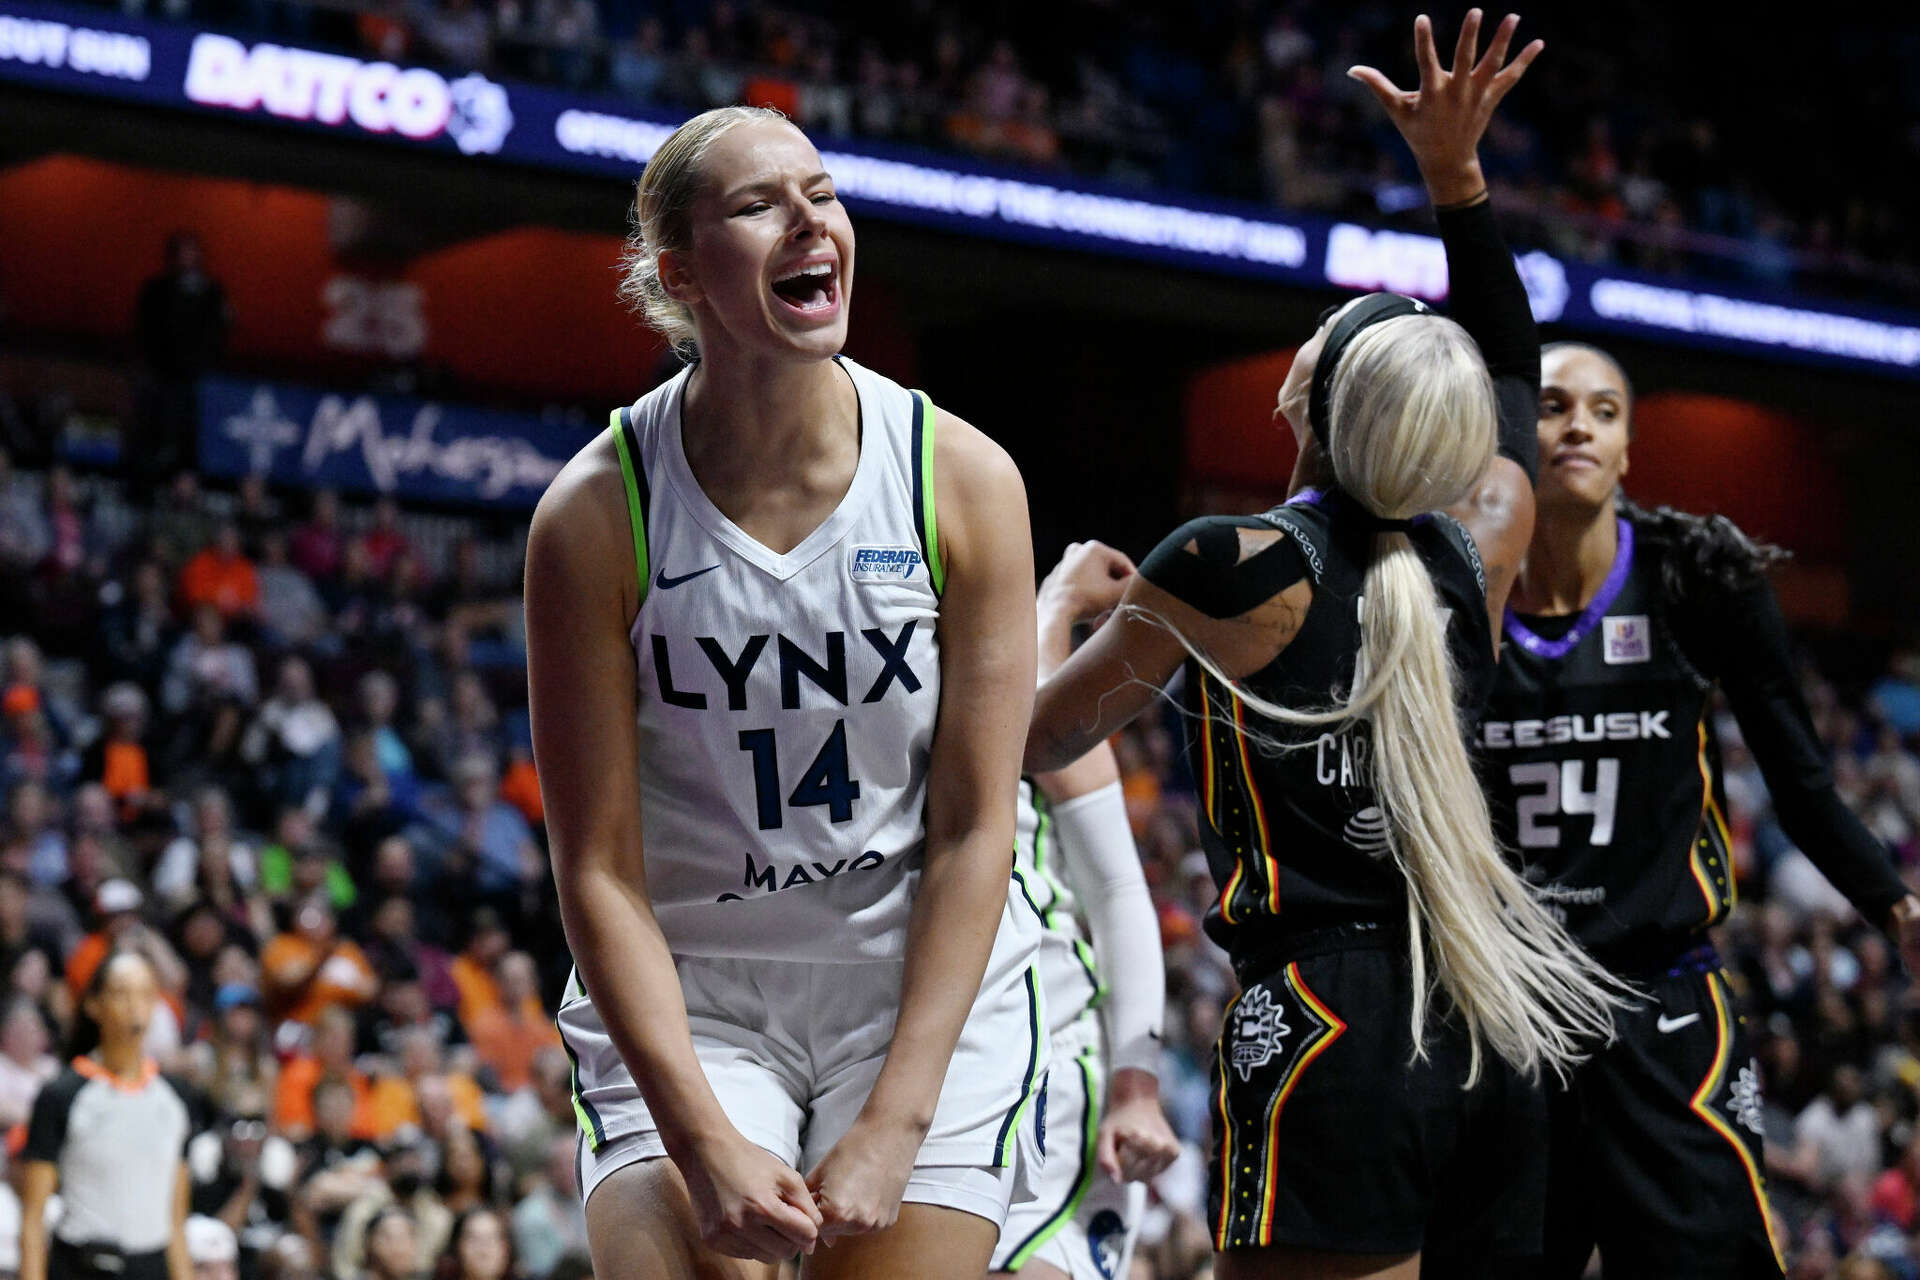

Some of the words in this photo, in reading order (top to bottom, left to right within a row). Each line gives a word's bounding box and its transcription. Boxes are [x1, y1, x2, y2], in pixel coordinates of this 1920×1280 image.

[853, 562, 905, 574] INSURANCE
[855, 549, 922, 565] FEDERATED
[651, 619, 922, 711] LYNX
[1474, 710, 1672, 749] EESUSK
[738, 718, 861, 831] 14
[1317, 732, 1366, 787] CAR
[1508, 757, 1620, 848] 24
